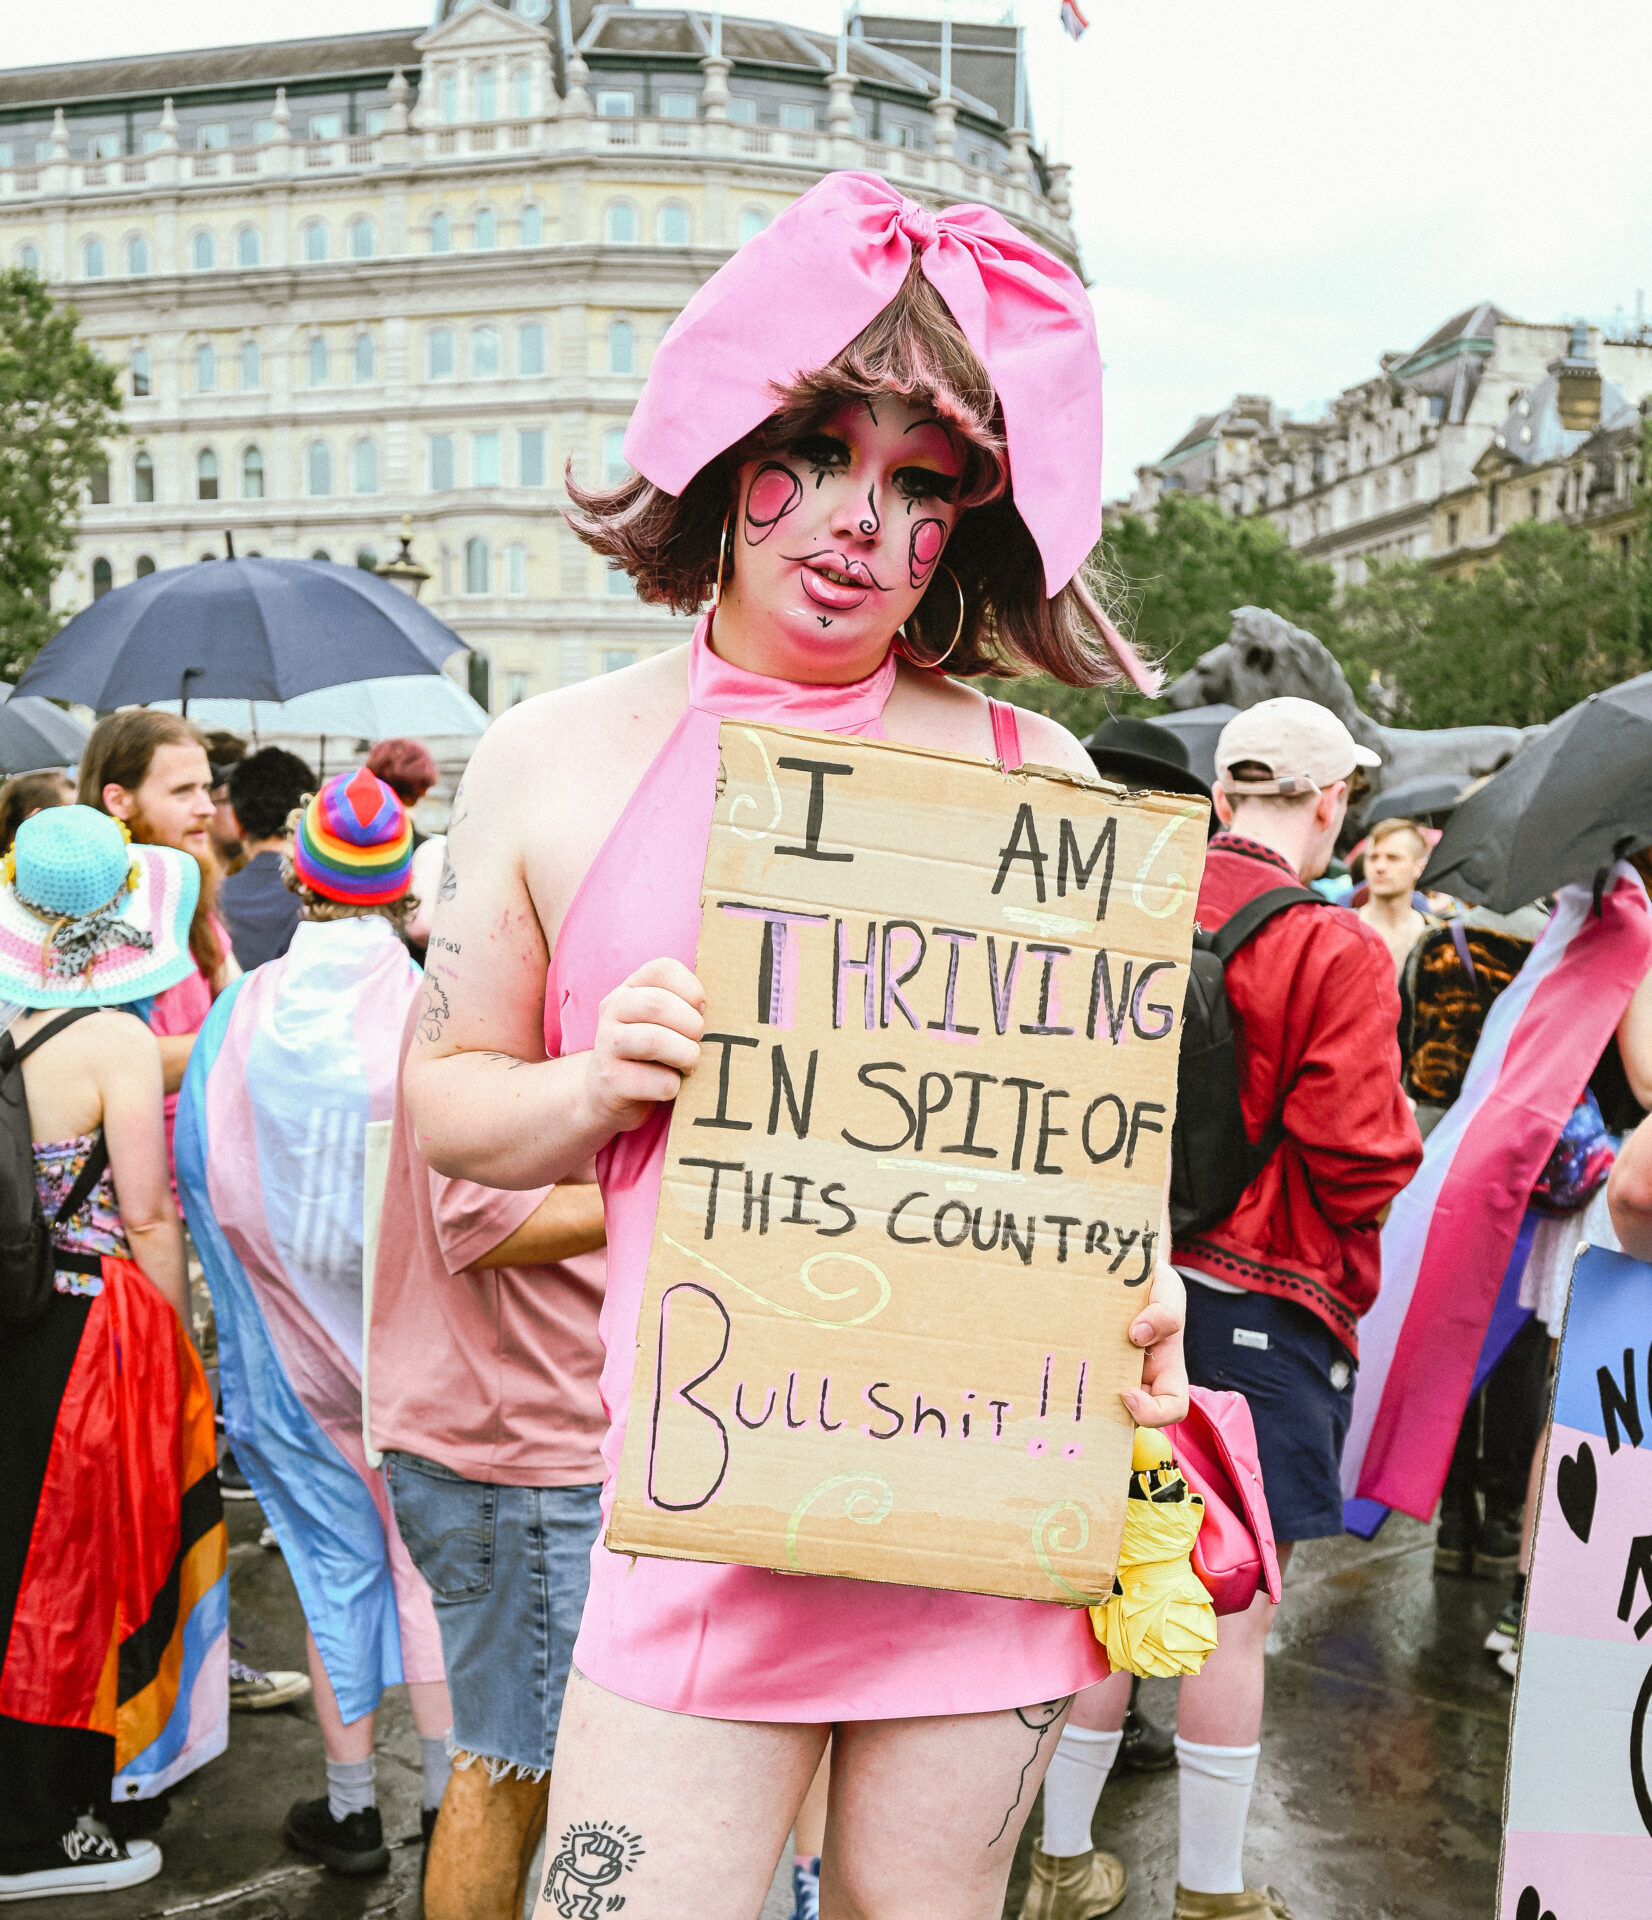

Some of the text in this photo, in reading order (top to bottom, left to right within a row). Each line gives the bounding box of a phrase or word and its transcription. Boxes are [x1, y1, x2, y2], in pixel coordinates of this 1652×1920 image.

[774, 756, 1117, 922] I AM
[716, 901, 1177, 1046] THRIVING
[691, 1032, 1166, 1175] IN SPITE OF
[678, 1158, 857, 1240] THIS
